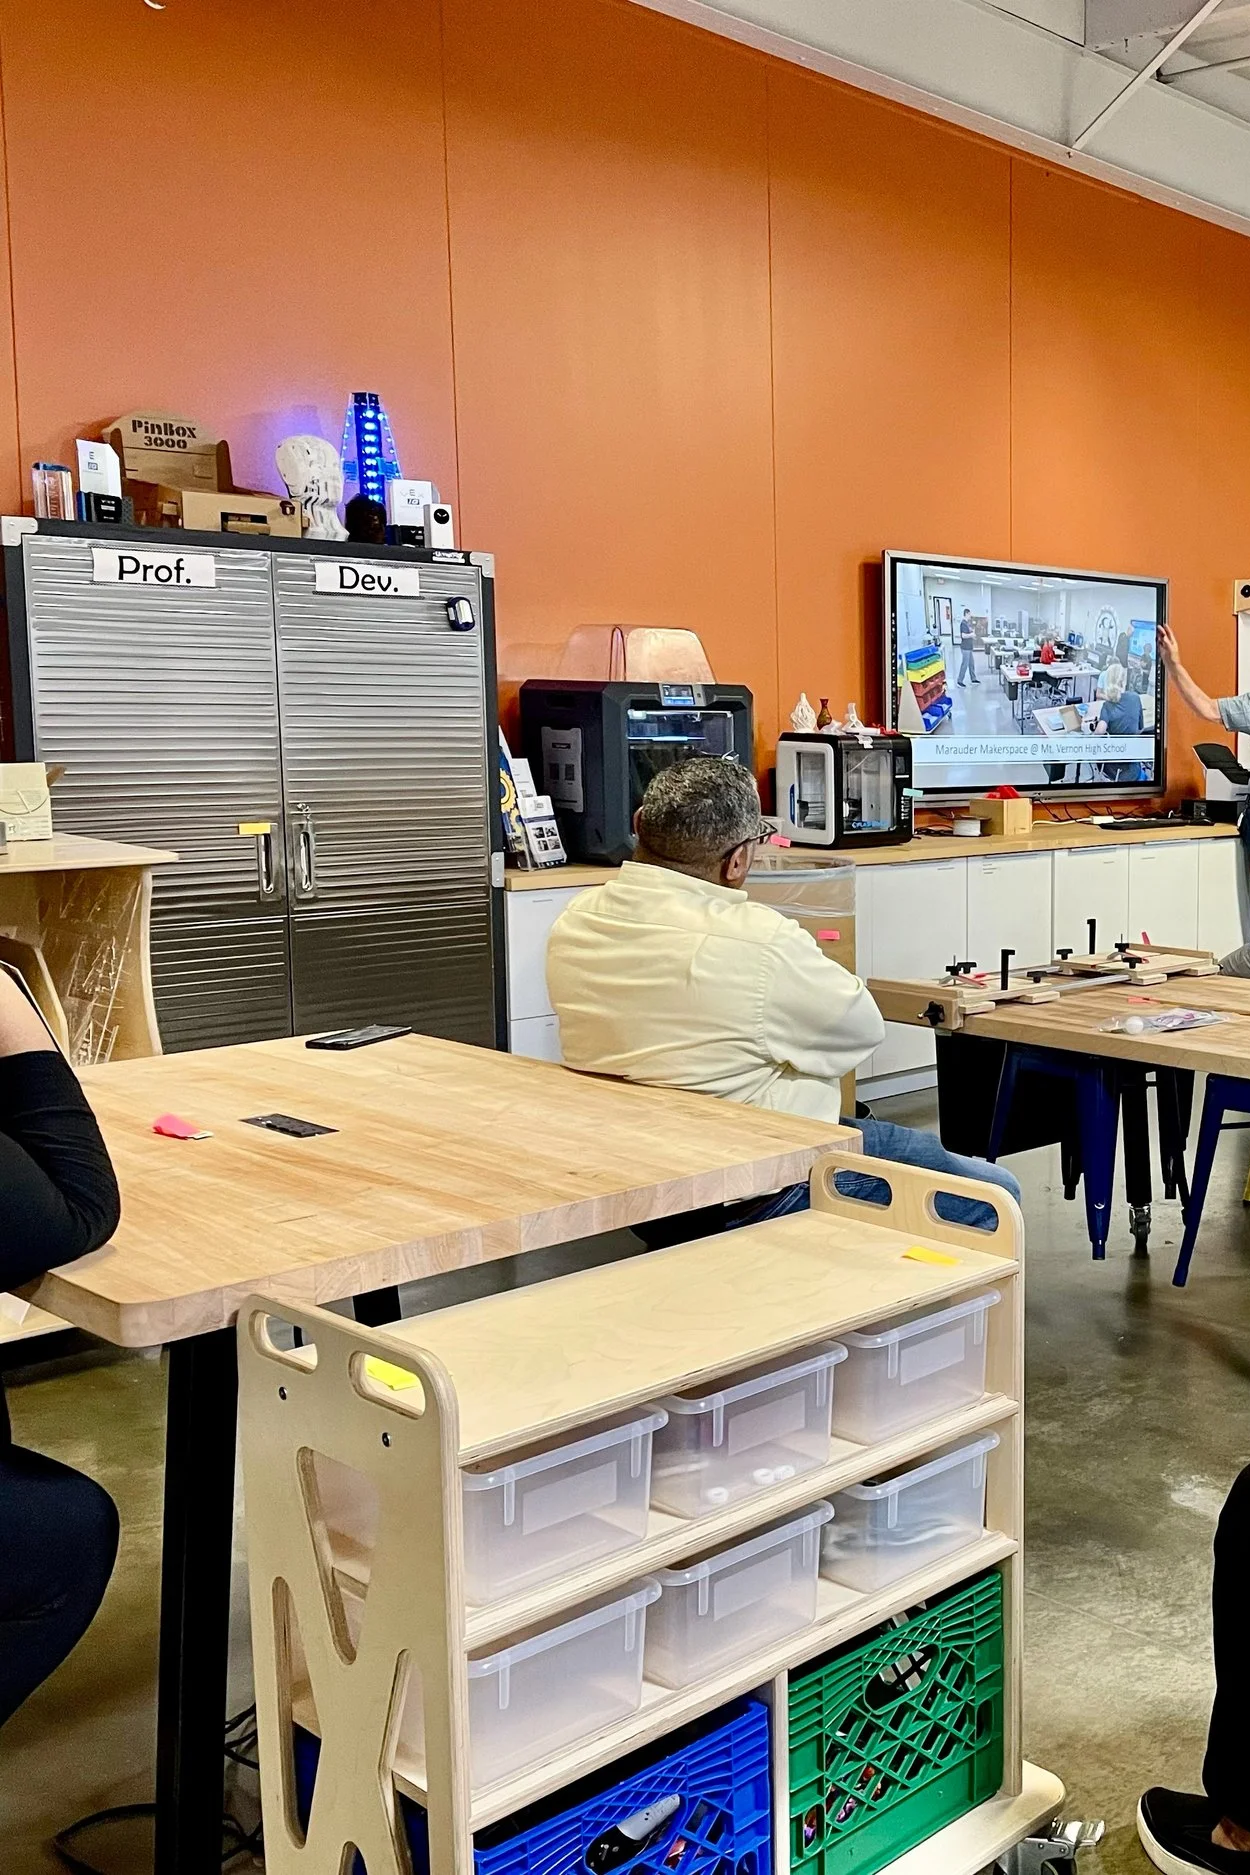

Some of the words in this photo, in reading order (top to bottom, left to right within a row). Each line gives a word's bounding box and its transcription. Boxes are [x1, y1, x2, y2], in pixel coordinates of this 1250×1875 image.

[131, 419, 197, 439] PinBox
[143, 436, 188, 449] 3000
[117, 555, 192, 584] Prof.
[338, 565, 399, 593] Dev.
[935, 744, 978, 755] Marauder
[980, 744, 1029, 756] Makerspace
[1030, 743, 1039, 755] @
[1056, 743, 1083, 754] Vernon
[1085, 743, 1102, 755] High
[1103, 743, 1127, 753] School
